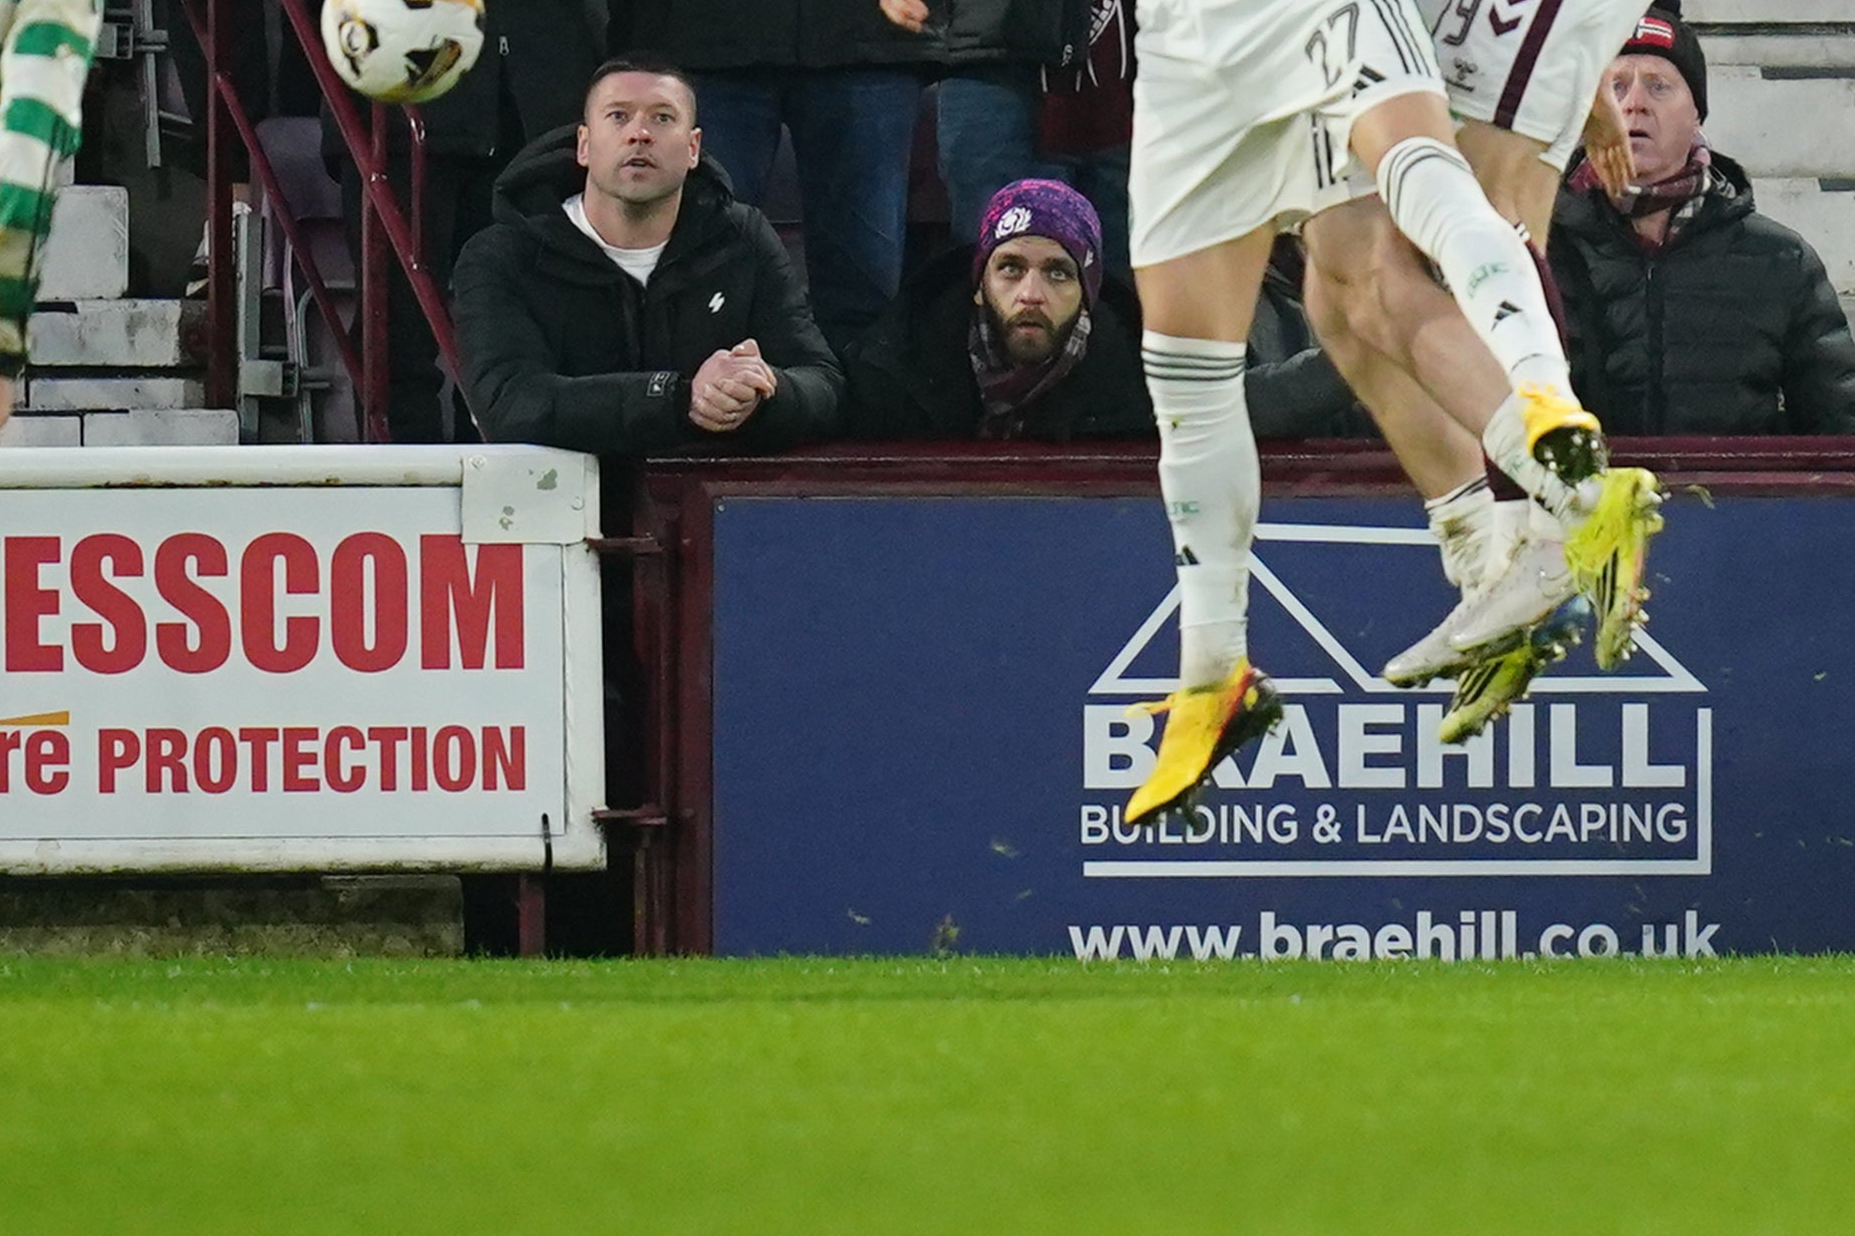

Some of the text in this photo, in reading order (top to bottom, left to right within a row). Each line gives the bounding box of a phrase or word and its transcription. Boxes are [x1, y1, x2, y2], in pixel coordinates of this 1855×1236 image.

[1304, 1, 1360, 91] 27
[97, 725, 526, 794] PROTECTION
[1083, 702, 1686, 790] BAEHILL
[1314, 804, 1342, 844] &
[1357, 804, 1688, 843] LANDSCAPING
[1068, 910, 1722, 961] www.braehill.co.uk
